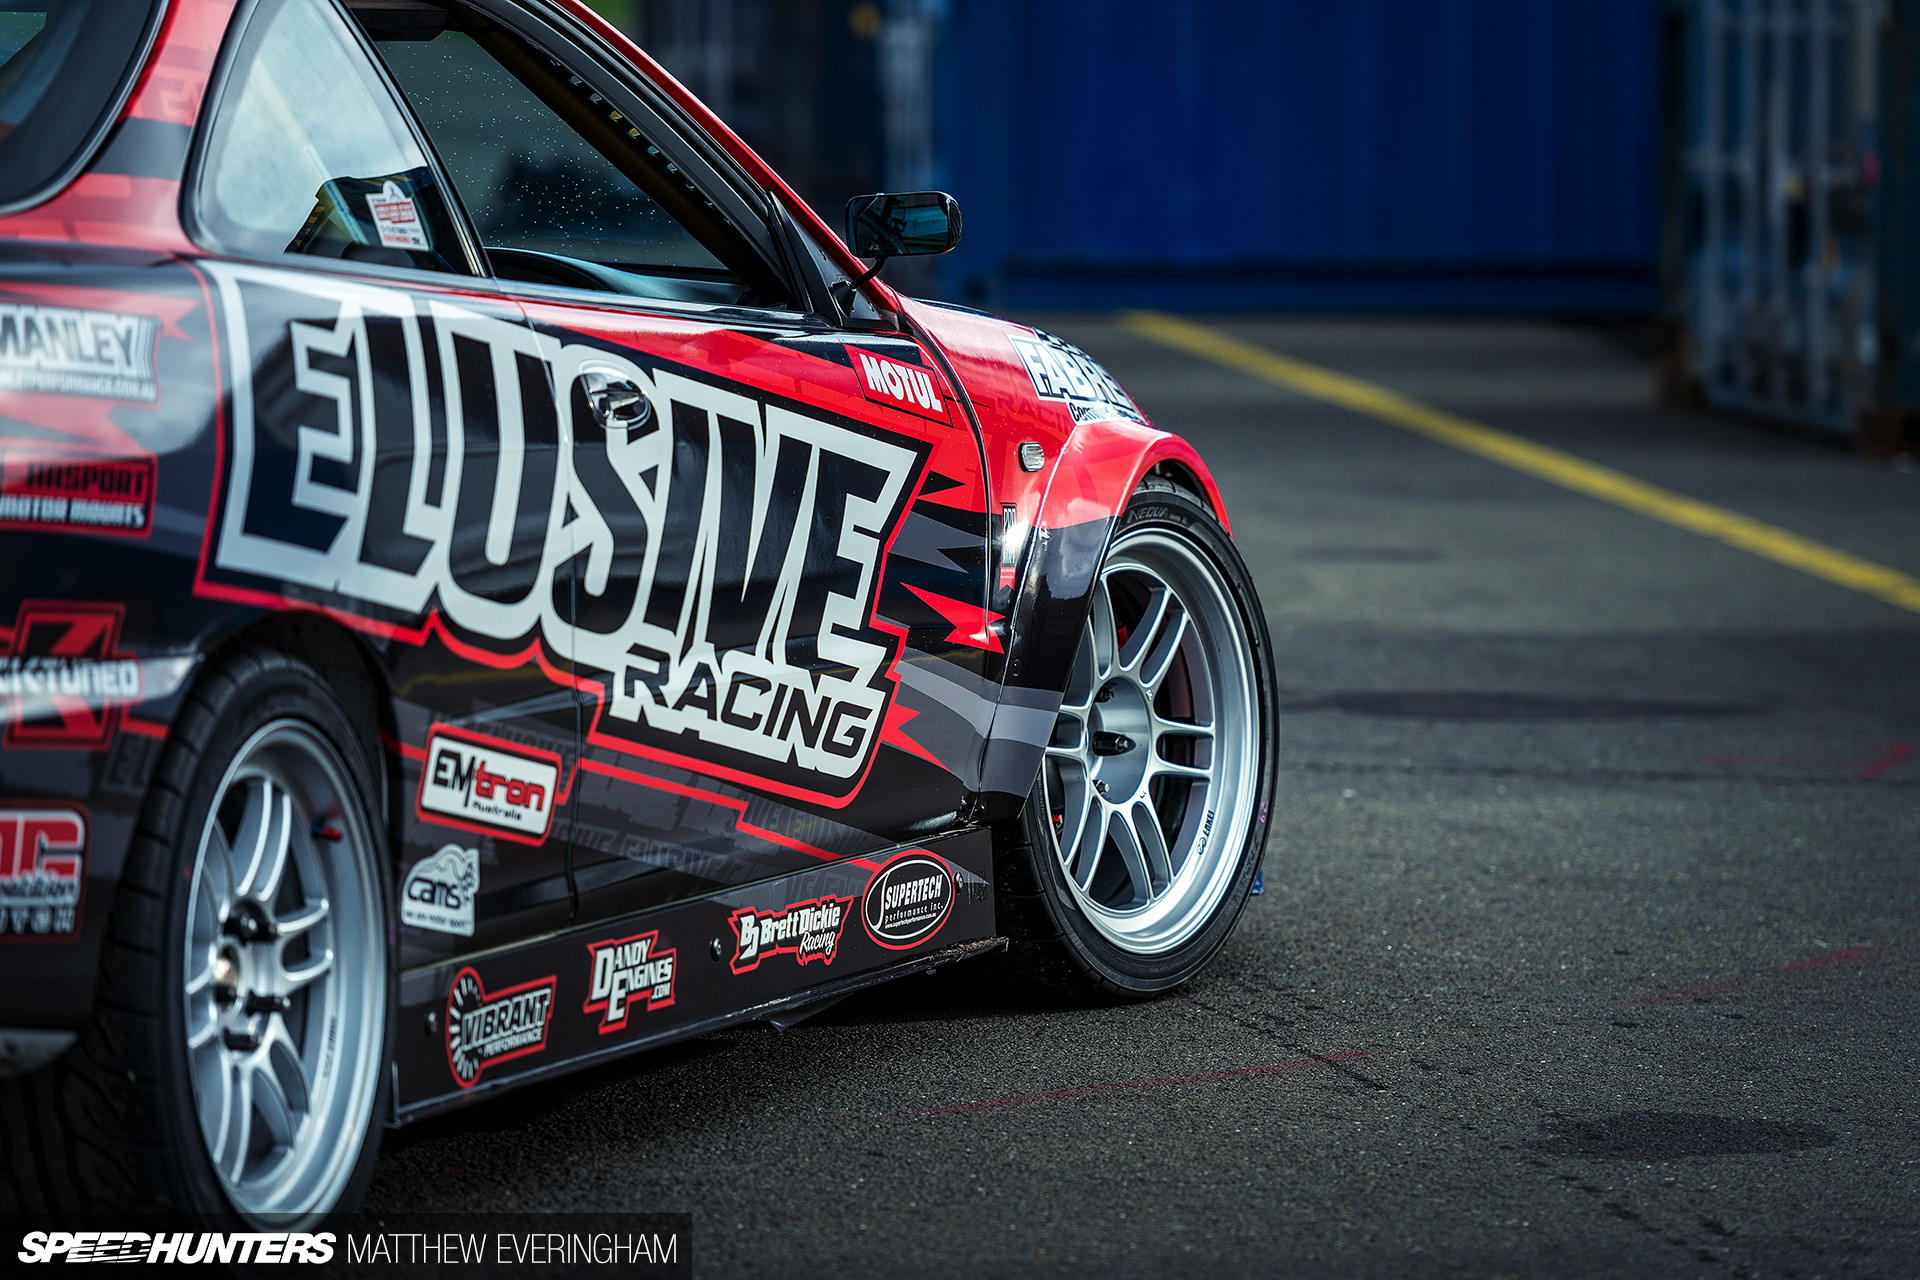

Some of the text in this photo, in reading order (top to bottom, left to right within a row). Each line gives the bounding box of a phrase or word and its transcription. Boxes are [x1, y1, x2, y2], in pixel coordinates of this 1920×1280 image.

[858, 352, 943, 413] MOTUL
[226, 268, 910, 690] ELUSIVE
[623, 642, 874, 760] RACING
[432, 749, 546, 812] EMtron
[884, 873, 944, 911] SUPERTECH
[884, 901, 945, 925] performance inc.
[760, 911, 799, 946] Brett
[798, 902, 841, 935] Dickie
[799, 927, 837, 956] Racing
[591, 938, 652, 1001] DANDY
[607, 956, 674, 1022] ENGINES
[461, 987, 552, 1053] VIBRANT
